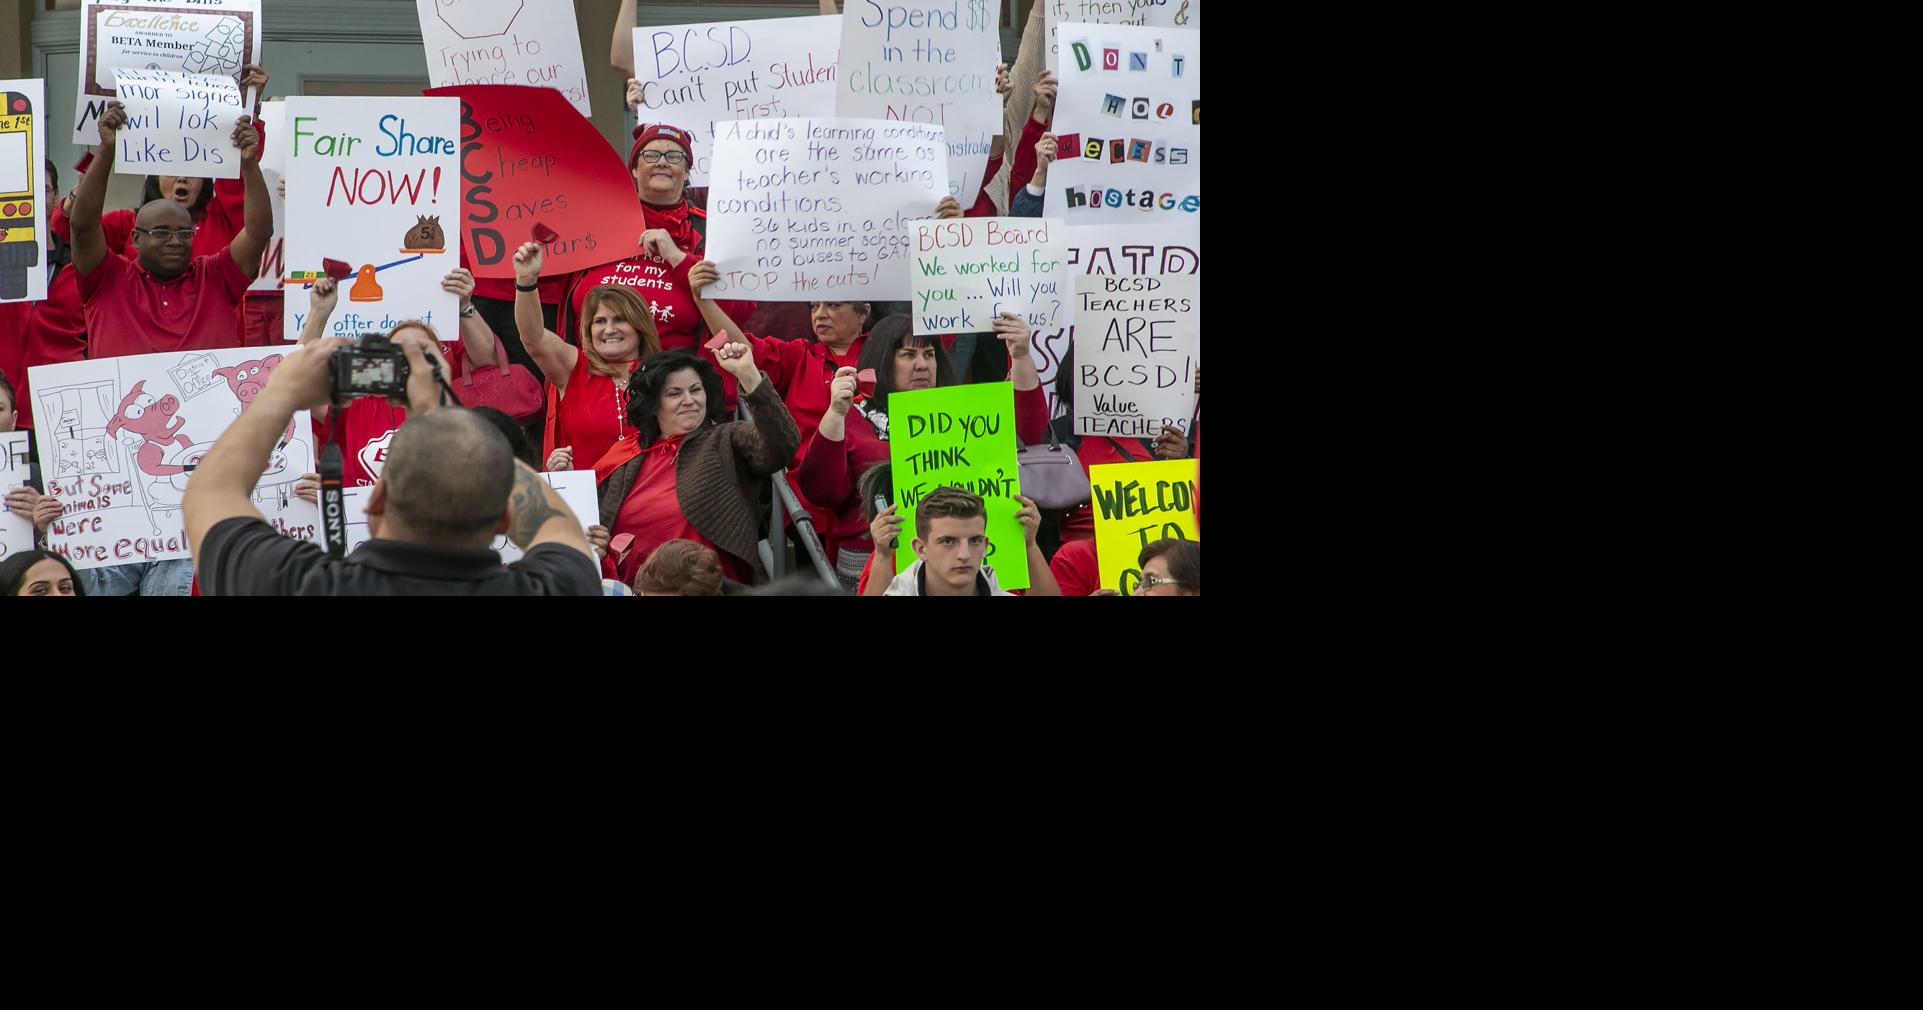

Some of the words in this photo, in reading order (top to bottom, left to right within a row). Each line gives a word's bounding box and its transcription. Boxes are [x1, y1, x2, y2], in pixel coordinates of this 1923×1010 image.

[104, 11, 199, 32] Excellence
[861, 0, 958, 41] Spend
[1079, 0, 1122, 16] then
[112, 36, 142, 47] BETA
[146, 39, 195, 51] Member
[440, 46, 507, 74] Trying
[512, 34, 541, 55] to
[883, 46, 903, 62] in
[912, 38, 956, 63] the
[527, 65, 562, 84] our
[643, 75, 706, 109] Can't
[725, 71, 760, 110] put
[15, 116, 31, 129] 1st
[126, 105, 160, 130] wil
[179, 109, 218, 130] lok
[886, 102, 953, 126] NOT
[294, 116, 361, 157] Fair
[376, 114, 455, 157] Share
[807, 120, 875, 148] learning
[123, 137, 171, 163] Like
[184, 137, 223, 164] Dis
[756, 148, 790, 165] are
[808, 141, 840, 161] the
[852, 145, 908, 162] same
[916, 146, 935, 162] as
[326, 166, 441, 207] NOW!
[737, 165, 840, 191] teacher's
[856, 162, 933, 190] working
[752, 218, 779, 234] 36
[788, 217, 830, 234] kids
[838, 221, 857, 233] in
[863, 220, 874, 231] a
[919, 223, 973, 251] BCSD
[987, 220, 1049, 245] Board
[756, 238, 780, 254] no
[790, 235, 856, 251] summer
[863, 232, 911, 248] schoo
[616, 262, 640, 273] for
[644, 266, 667, 278] my
[758, 254, 782, 268] no
[793, 249, 844, 267] buses
[849, 248, 868, 261] to
[918, 255, 947, 276] We
[954, 251, 1020, 275] worked
[1031, 249, 1060, 274] for
[601, 274, 673, 291] students
[714, 270, 779, 292] STOP
[792, 271, 820, 292] the
[826, 264, 880, 288] cuts!
[1104, 278, 1161, 292] BCSD
[917, 288, 957, 313] you
[987, 276, 1021, 297] Will
[1030, 281, 1058, 304] you
[334, 313, 374, 332] offer
[923, 307, 975, 331] work
[1029, 299, 1061, 327] us?
[1102, 316, 1178, 359] ARE
[1080, 356, 1191, 396] BCSD!
[1093, 393, 1138, 413] Value
[907, 413, 953, 438] DID
[959, 413, 1000, 442] YOU
[905, 446, 971, 476] THINK
[47, 475, 84, 498] But
[88, 473, 132, 497] Some
[901, 481, 928, 509] WE
[61, 495, 111, 515] nimals
[326, 490, 342, 545] SONY
[114, 529, 188, 560] equal
